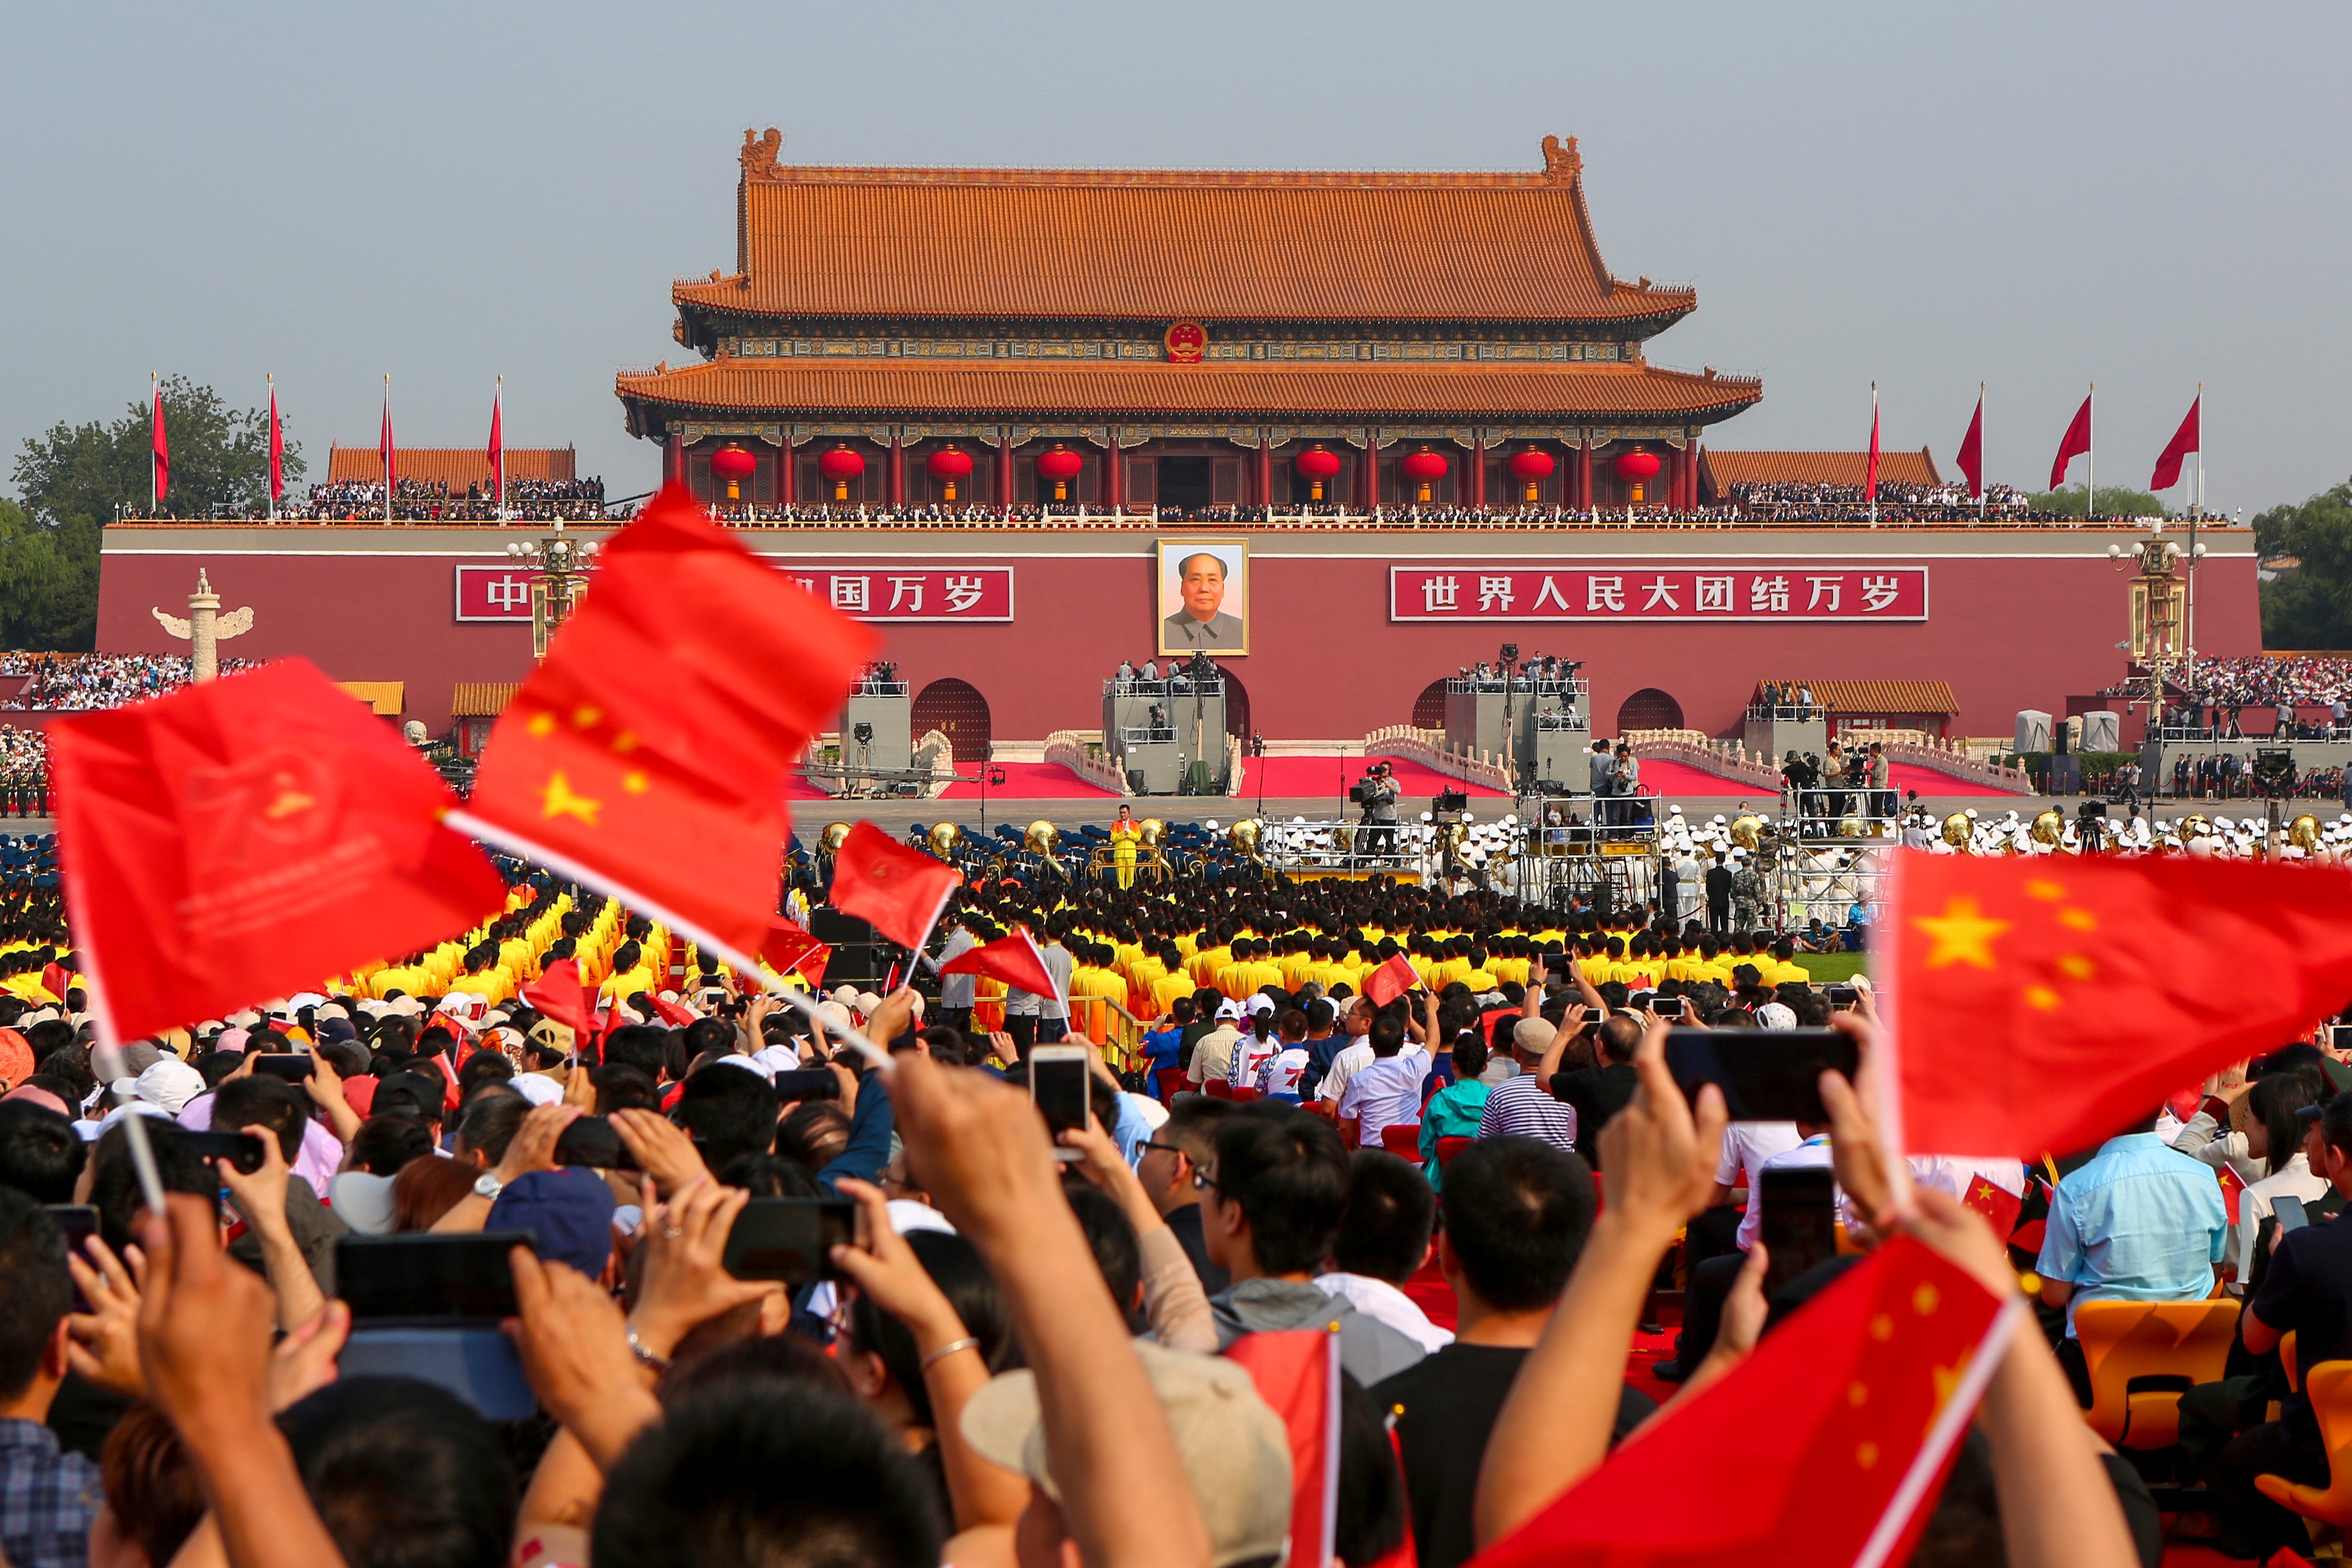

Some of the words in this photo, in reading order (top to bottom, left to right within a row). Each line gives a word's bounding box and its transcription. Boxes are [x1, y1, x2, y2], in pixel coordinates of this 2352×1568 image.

[1421, 575, 1899, 612] 世界人民大团结万岁
